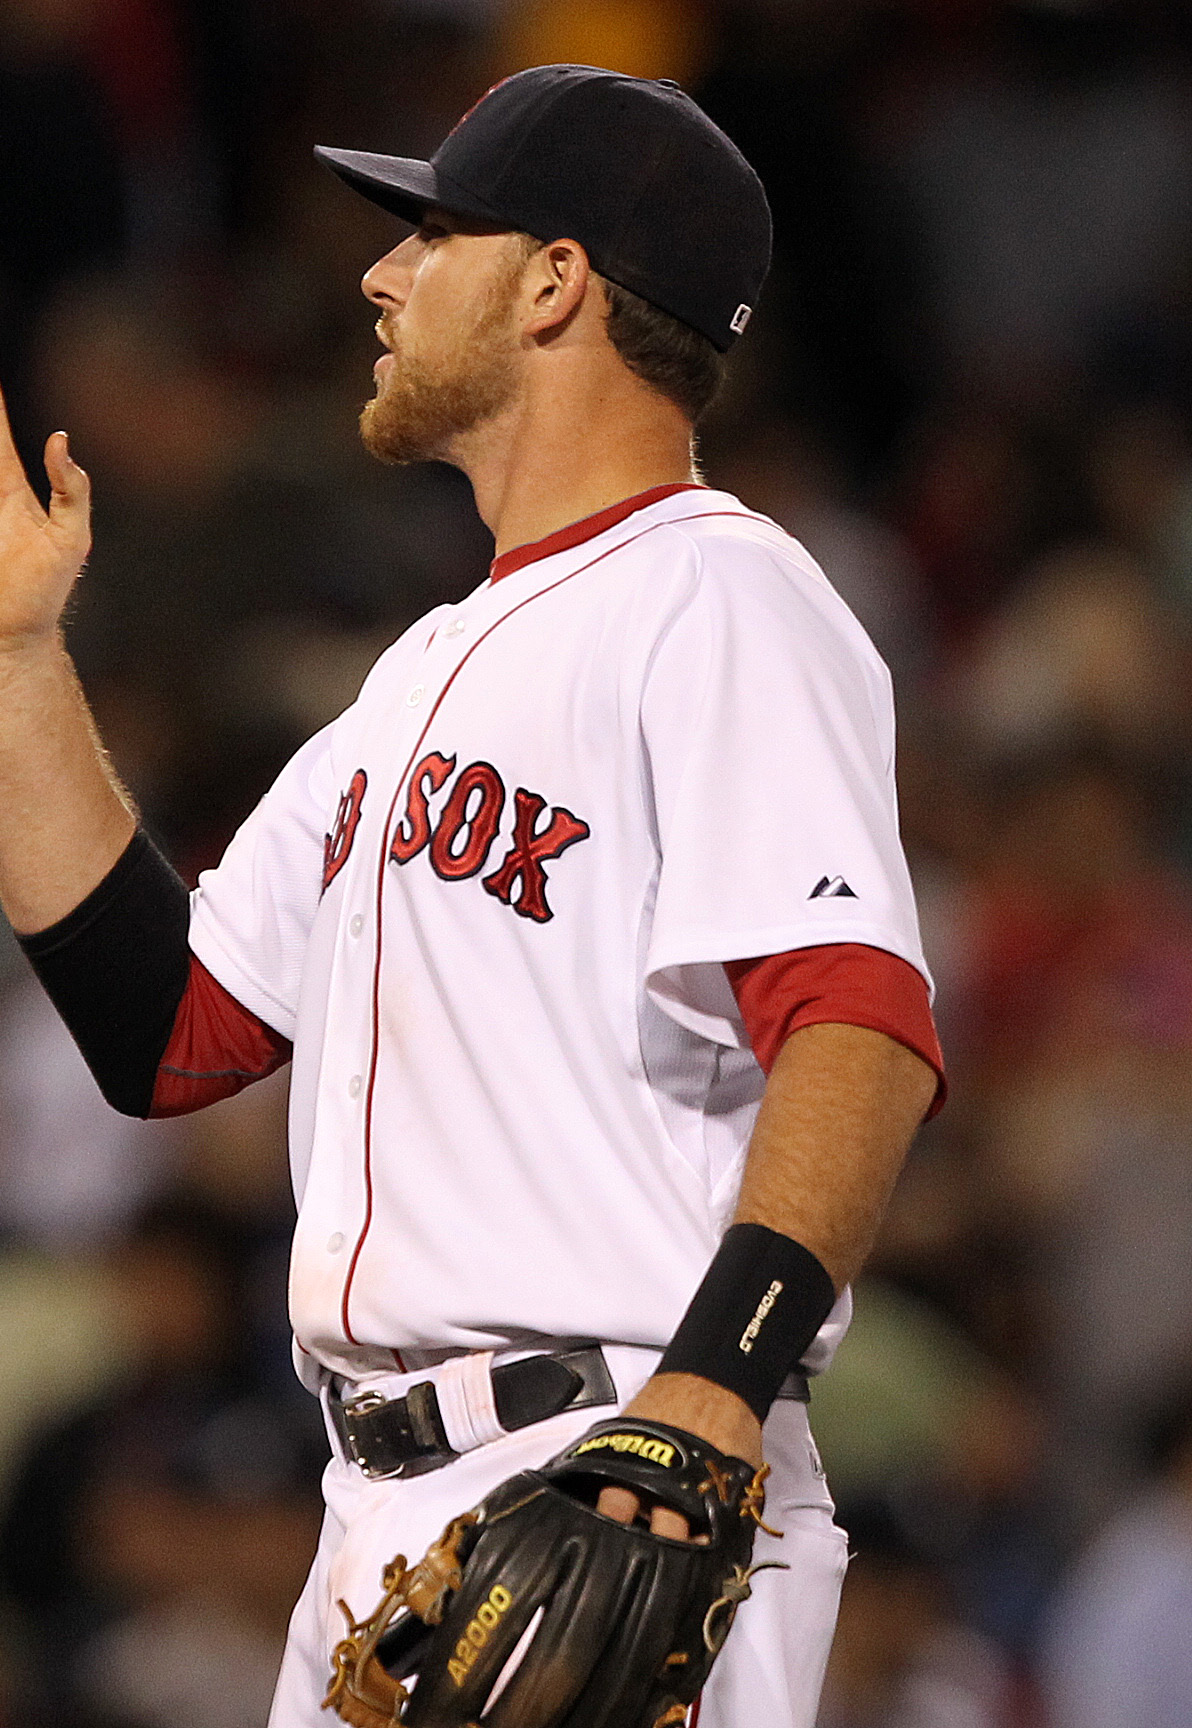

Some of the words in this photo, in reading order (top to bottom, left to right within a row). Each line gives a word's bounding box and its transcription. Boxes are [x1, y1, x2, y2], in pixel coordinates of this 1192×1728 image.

[388, 750, 591, 924] SOX
[573, 1434, 676, 1468] Wilson
[447, 1584, 512, 1688] A2000
